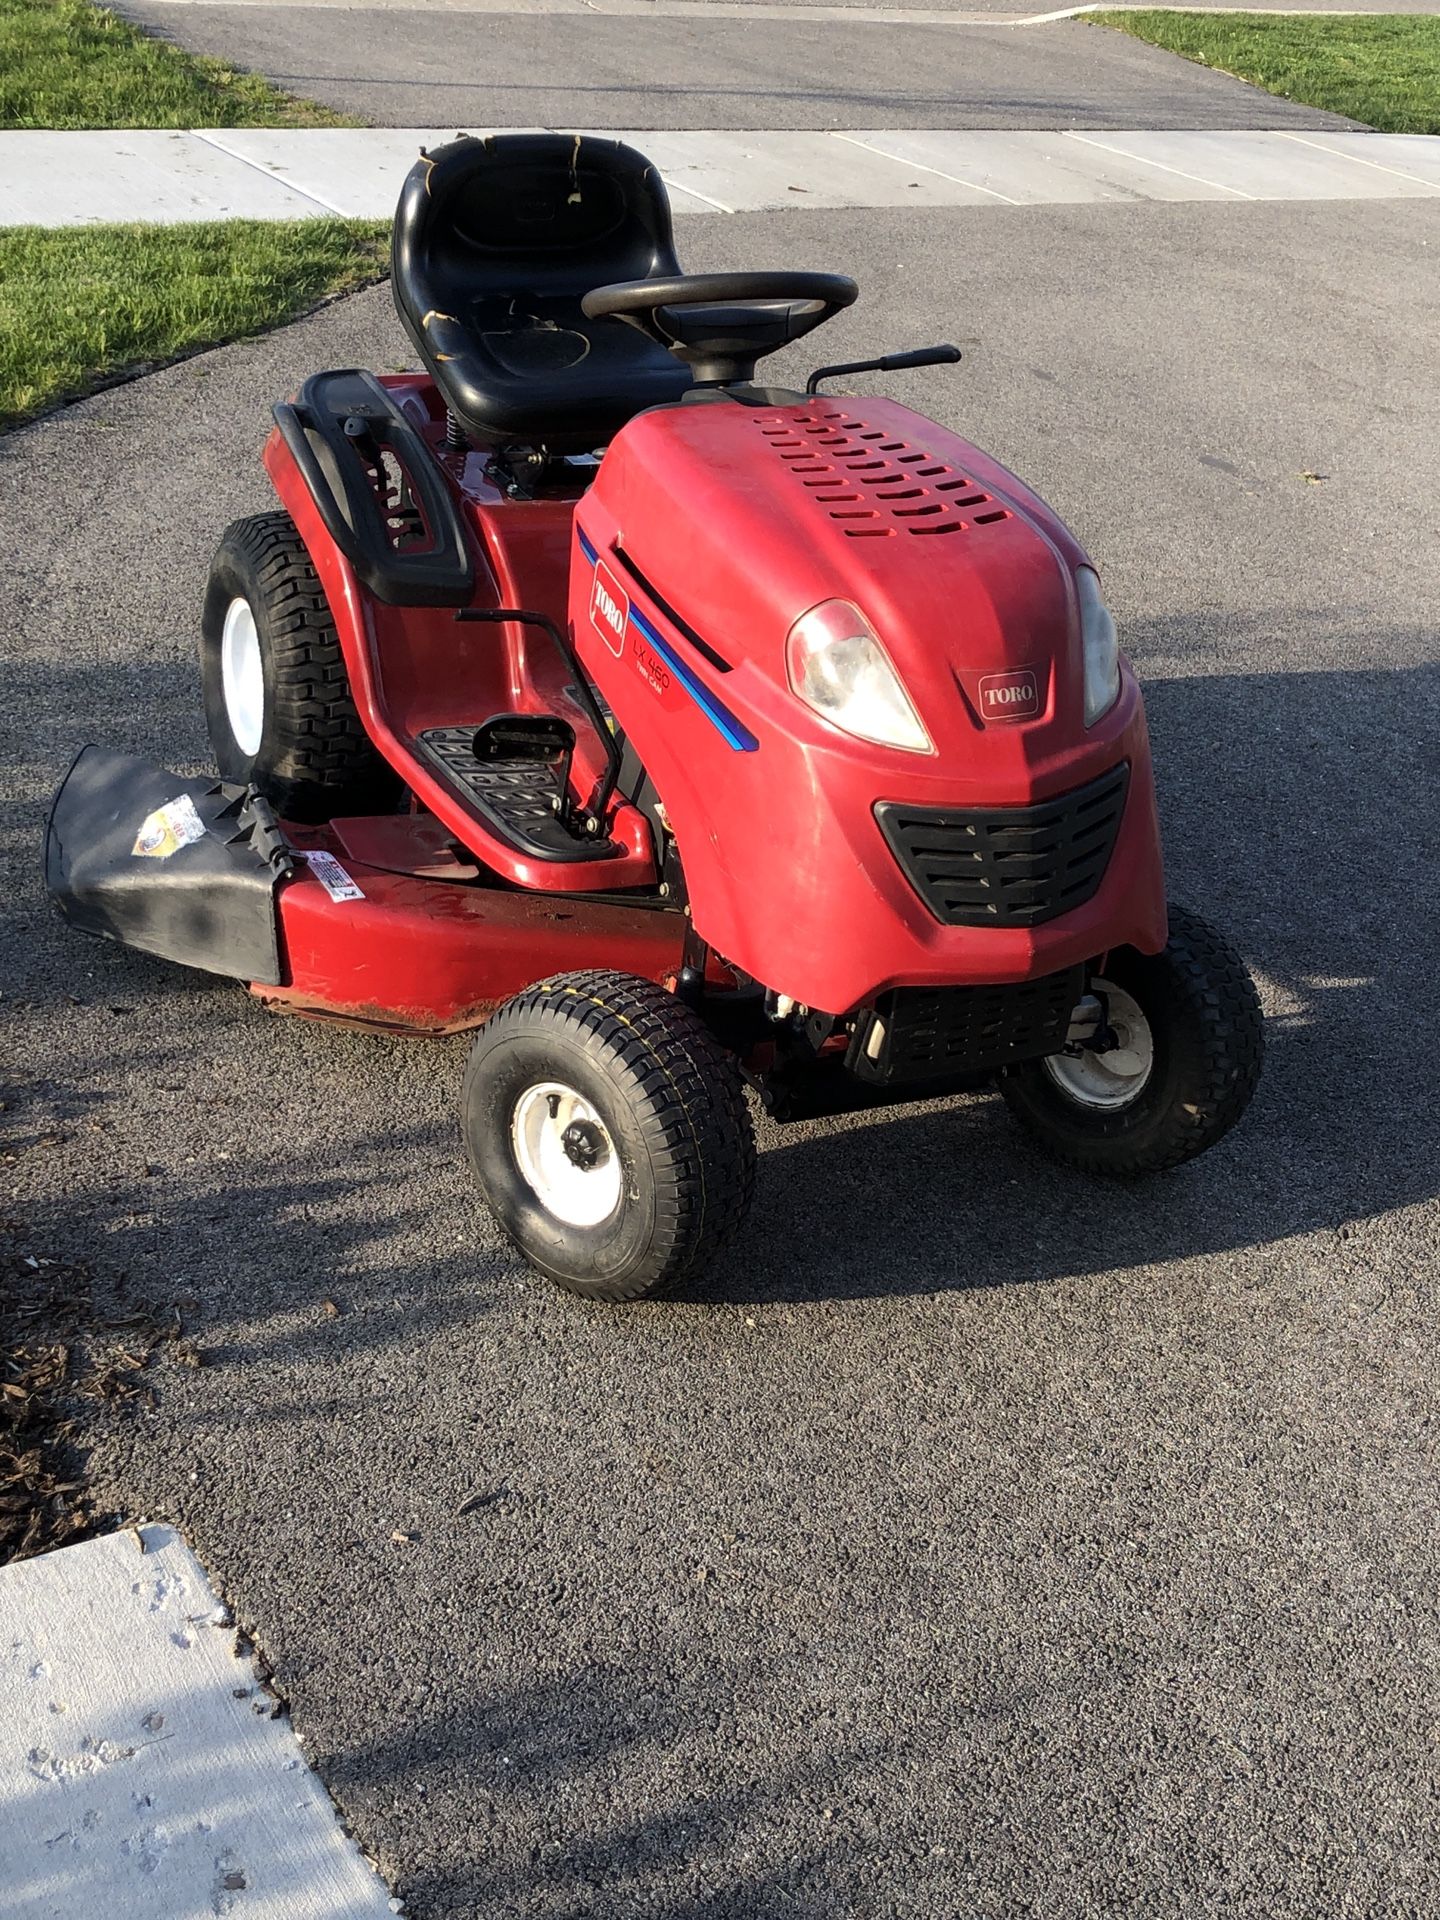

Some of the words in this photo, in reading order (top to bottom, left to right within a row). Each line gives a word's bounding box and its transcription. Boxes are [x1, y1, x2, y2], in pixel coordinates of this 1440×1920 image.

[595, 580, 623, 634] TORO
[632, 639, 646, 662] LX
[648, 657, 670, 689] 460
[648, 675, 662, 696] CAM
[984, 685, 1033, 705] TORO
